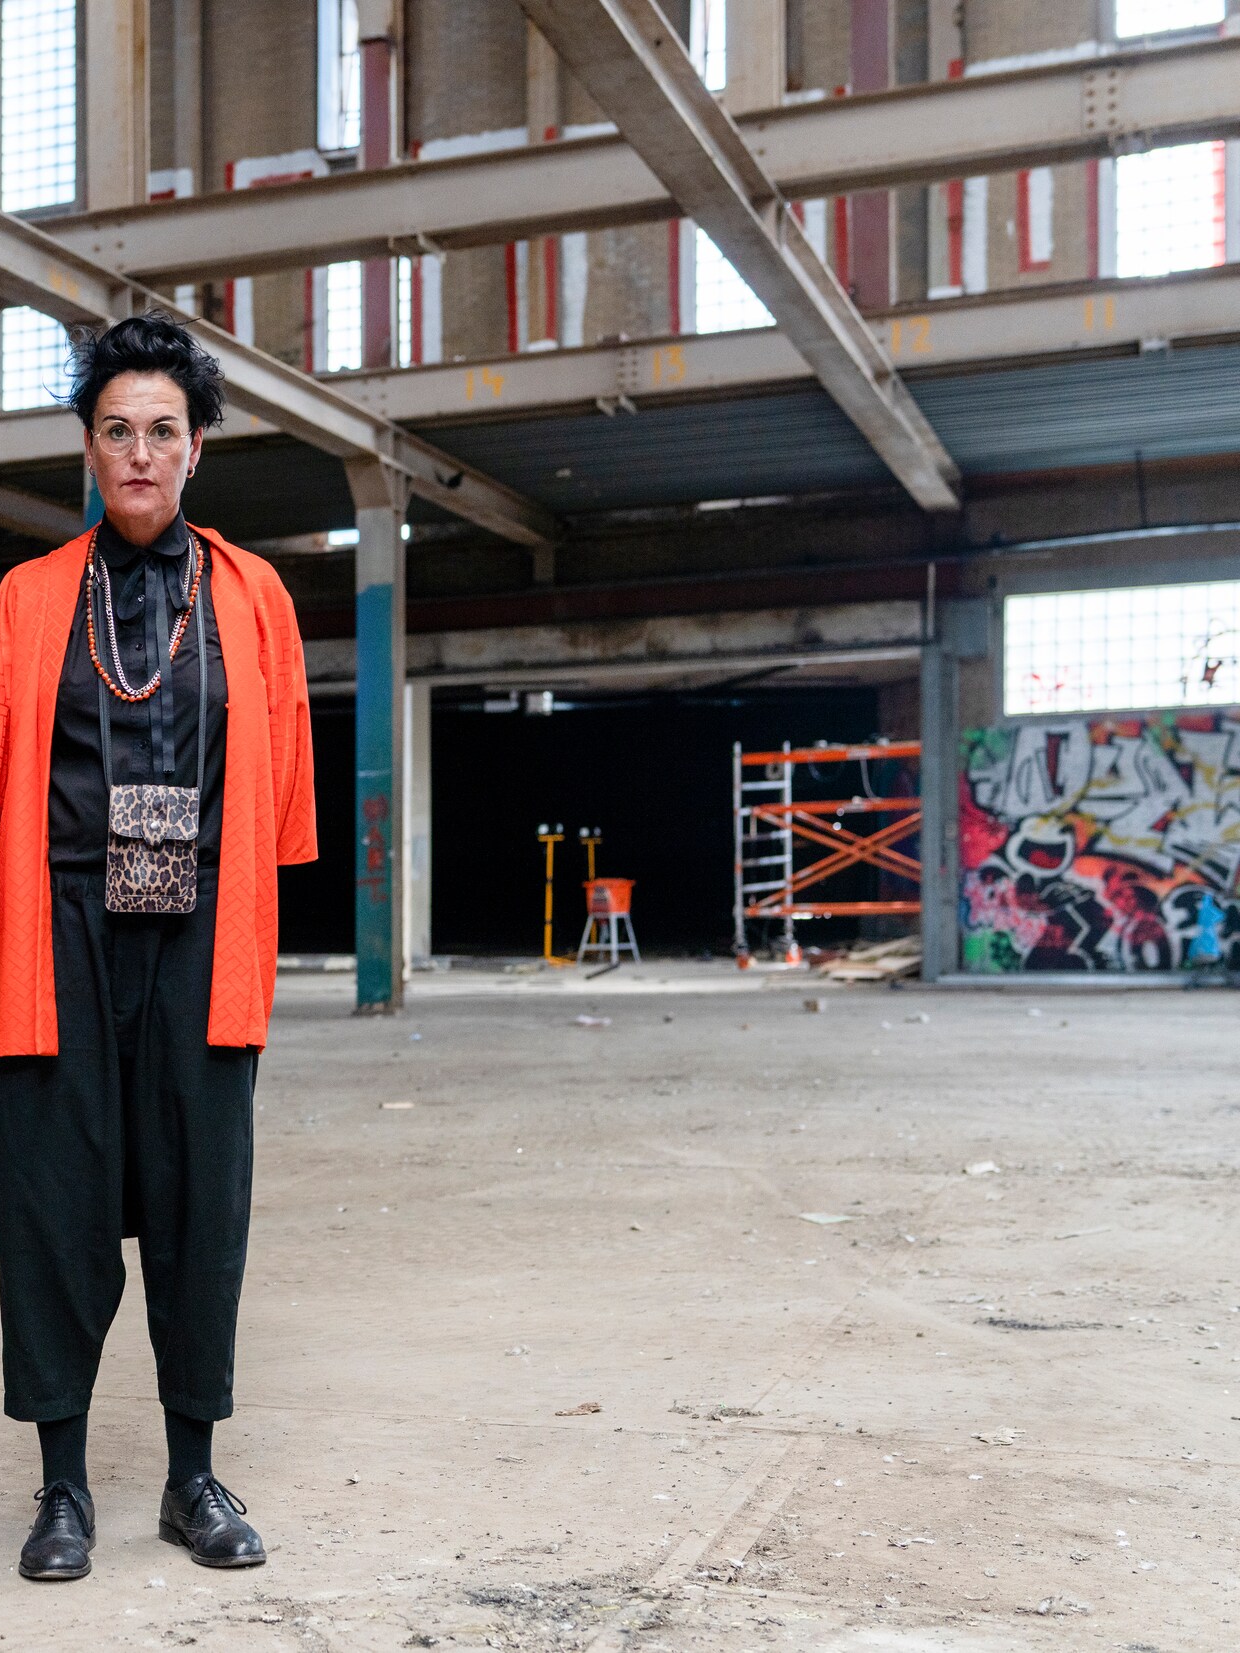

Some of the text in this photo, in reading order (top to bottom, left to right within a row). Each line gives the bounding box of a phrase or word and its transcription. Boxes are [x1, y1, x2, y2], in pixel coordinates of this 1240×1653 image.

[1083, 297, 1115, 332] 11
[890, 315, 933, 355] 12
[466, 366, 504, 400] 14
[652, 344, 686, 388] 13
